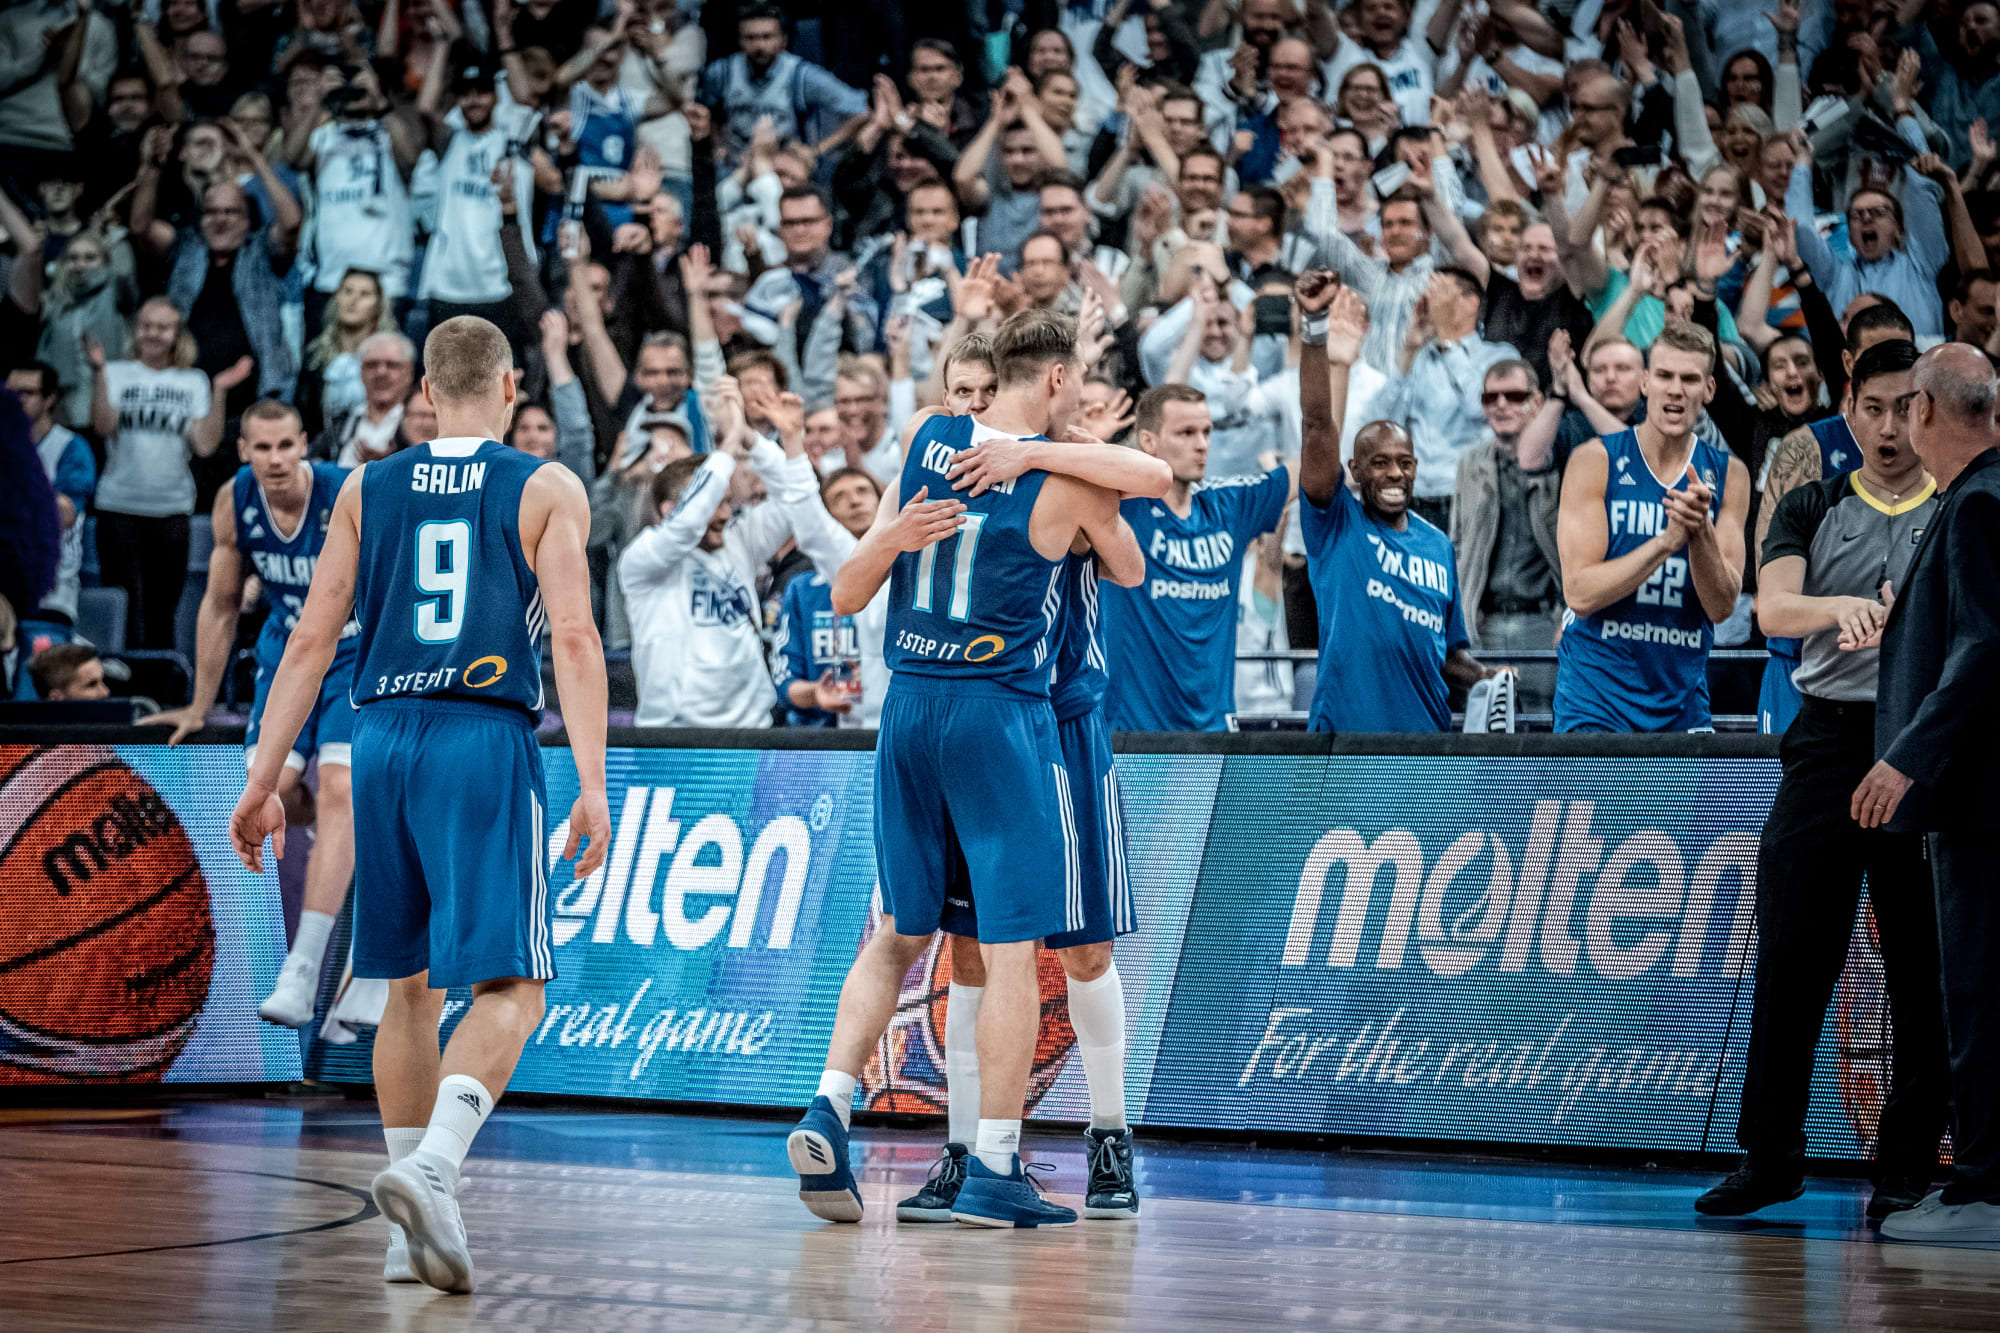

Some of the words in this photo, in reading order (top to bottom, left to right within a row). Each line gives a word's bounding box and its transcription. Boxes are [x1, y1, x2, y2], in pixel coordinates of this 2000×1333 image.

[411, 462, 487, 495] SALIN
[1150, 528, 1234, 570] FNLAND
[413, 518, 473, 645] 9
[1636, 557, 1688, 609] 22
[903, 633, 937, 657] STEP
[938, 642, 961, 660] IT
[1601, 619, 1702, 649] postnord
[376, 675, 388, 696] 3
[434, 667, 457, 689] IT
[550, 786, 812, 950] olten
[1281, 799, 1761, 980] molten
[536, 978, 653, 1048] real
[630, 1009, 774, 1081] game
[1238, 1006, 1337, 1088] For
[1336, 1005, 1432, 1086] the
[1432, 1013, 1574, 1092] real
